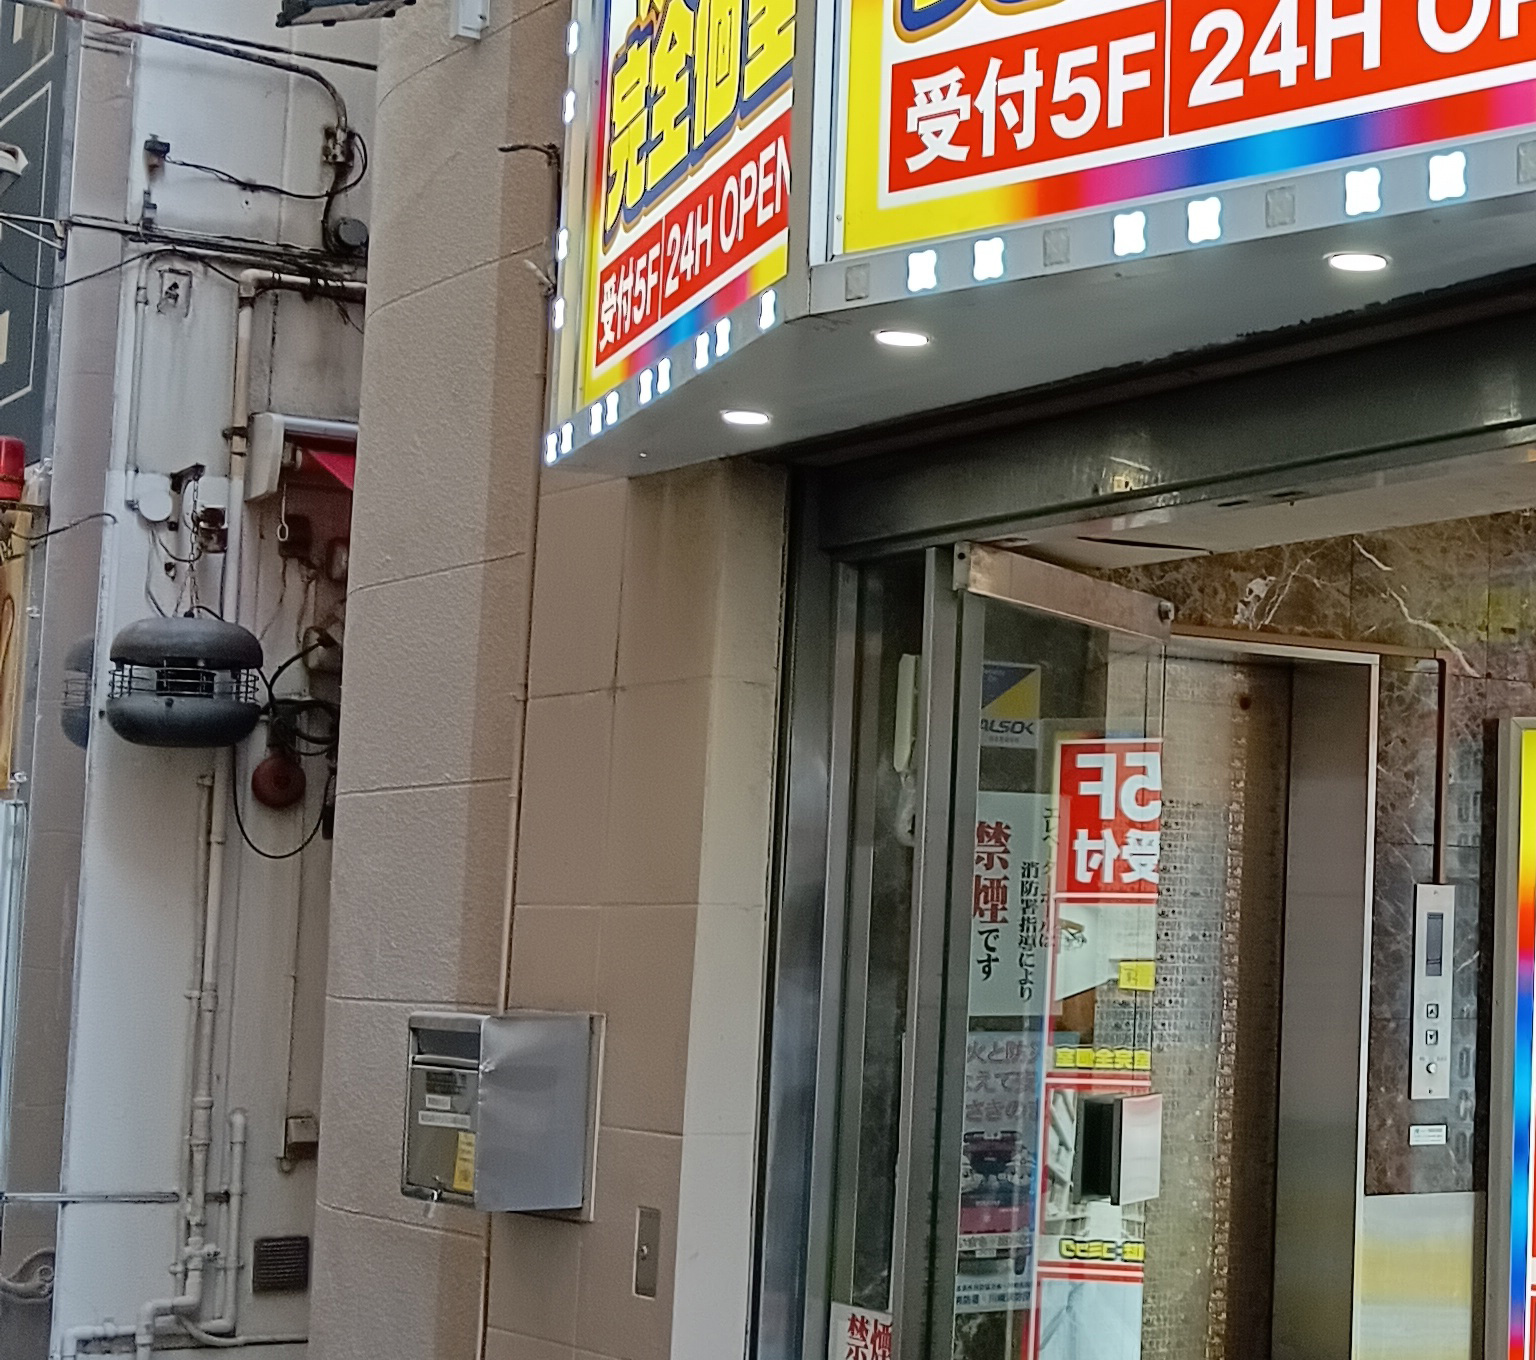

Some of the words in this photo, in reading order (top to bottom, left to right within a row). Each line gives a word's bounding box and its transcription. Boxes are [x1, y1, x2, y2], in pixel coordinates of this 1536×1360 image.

[905, 25, 1158, 172] 受付5F
[600, 242, 660, 352] 受付5F
[665, 194, 713, 298] 24H
[720, 135, 791, 253] OPEN
[973, 821, 1011, 980] 禁煙です
[1017, 861, 1040, 1001] 消防署指導により
